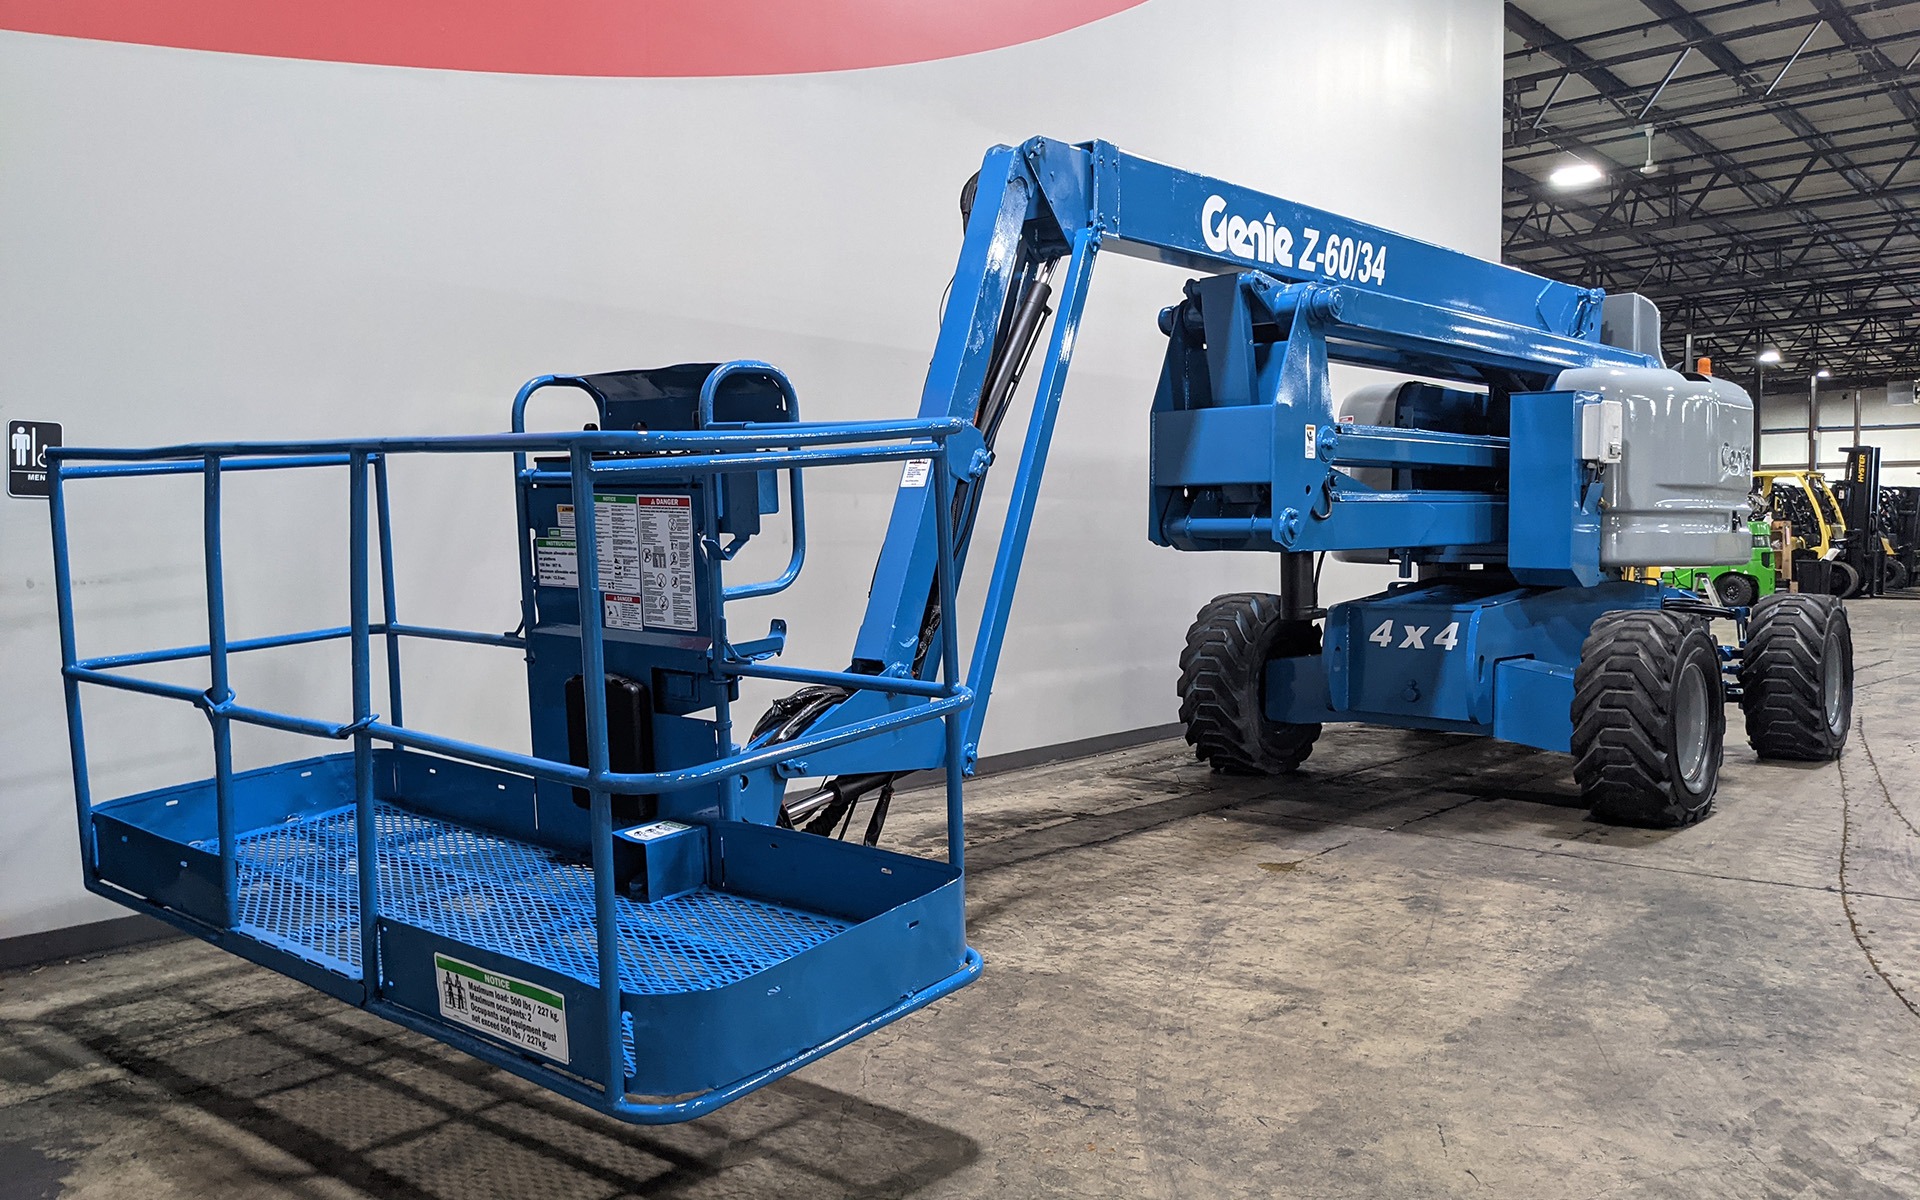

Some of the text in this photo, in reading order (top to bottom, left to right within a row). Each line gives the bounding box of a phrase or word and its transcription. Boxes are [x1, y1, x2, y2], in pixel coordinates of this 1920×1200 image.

[1202, 194, 1387, 286] Genie Z-60/34
[27, 473, 46, 481] MEN
[1858, 454, 1866, 482] HYSTER
[656, 498, 679, 506] DANGER
[484, 974, 511, 990] NOTICE
[468, 981, 495, 998] Maximum
[494, 990, 510, 1003] load:
[510, 996, 522, 1008] 500
[522, 1000, 532, 1011] lbs
[532, 1004, 537, 1014] /
[537, 1005, 549, 1017] 227
[469, 991, 532, 1022] Maximum occupants: 2
[470, 1002, 557, 1042] Occupants and equipment must
[471, 1014, 481, 1023] not
[481, 1018, 500, 1031] exceed
[500, 1023, 512, 1035] 500
[512, 1028, 521, 1039] lbs
